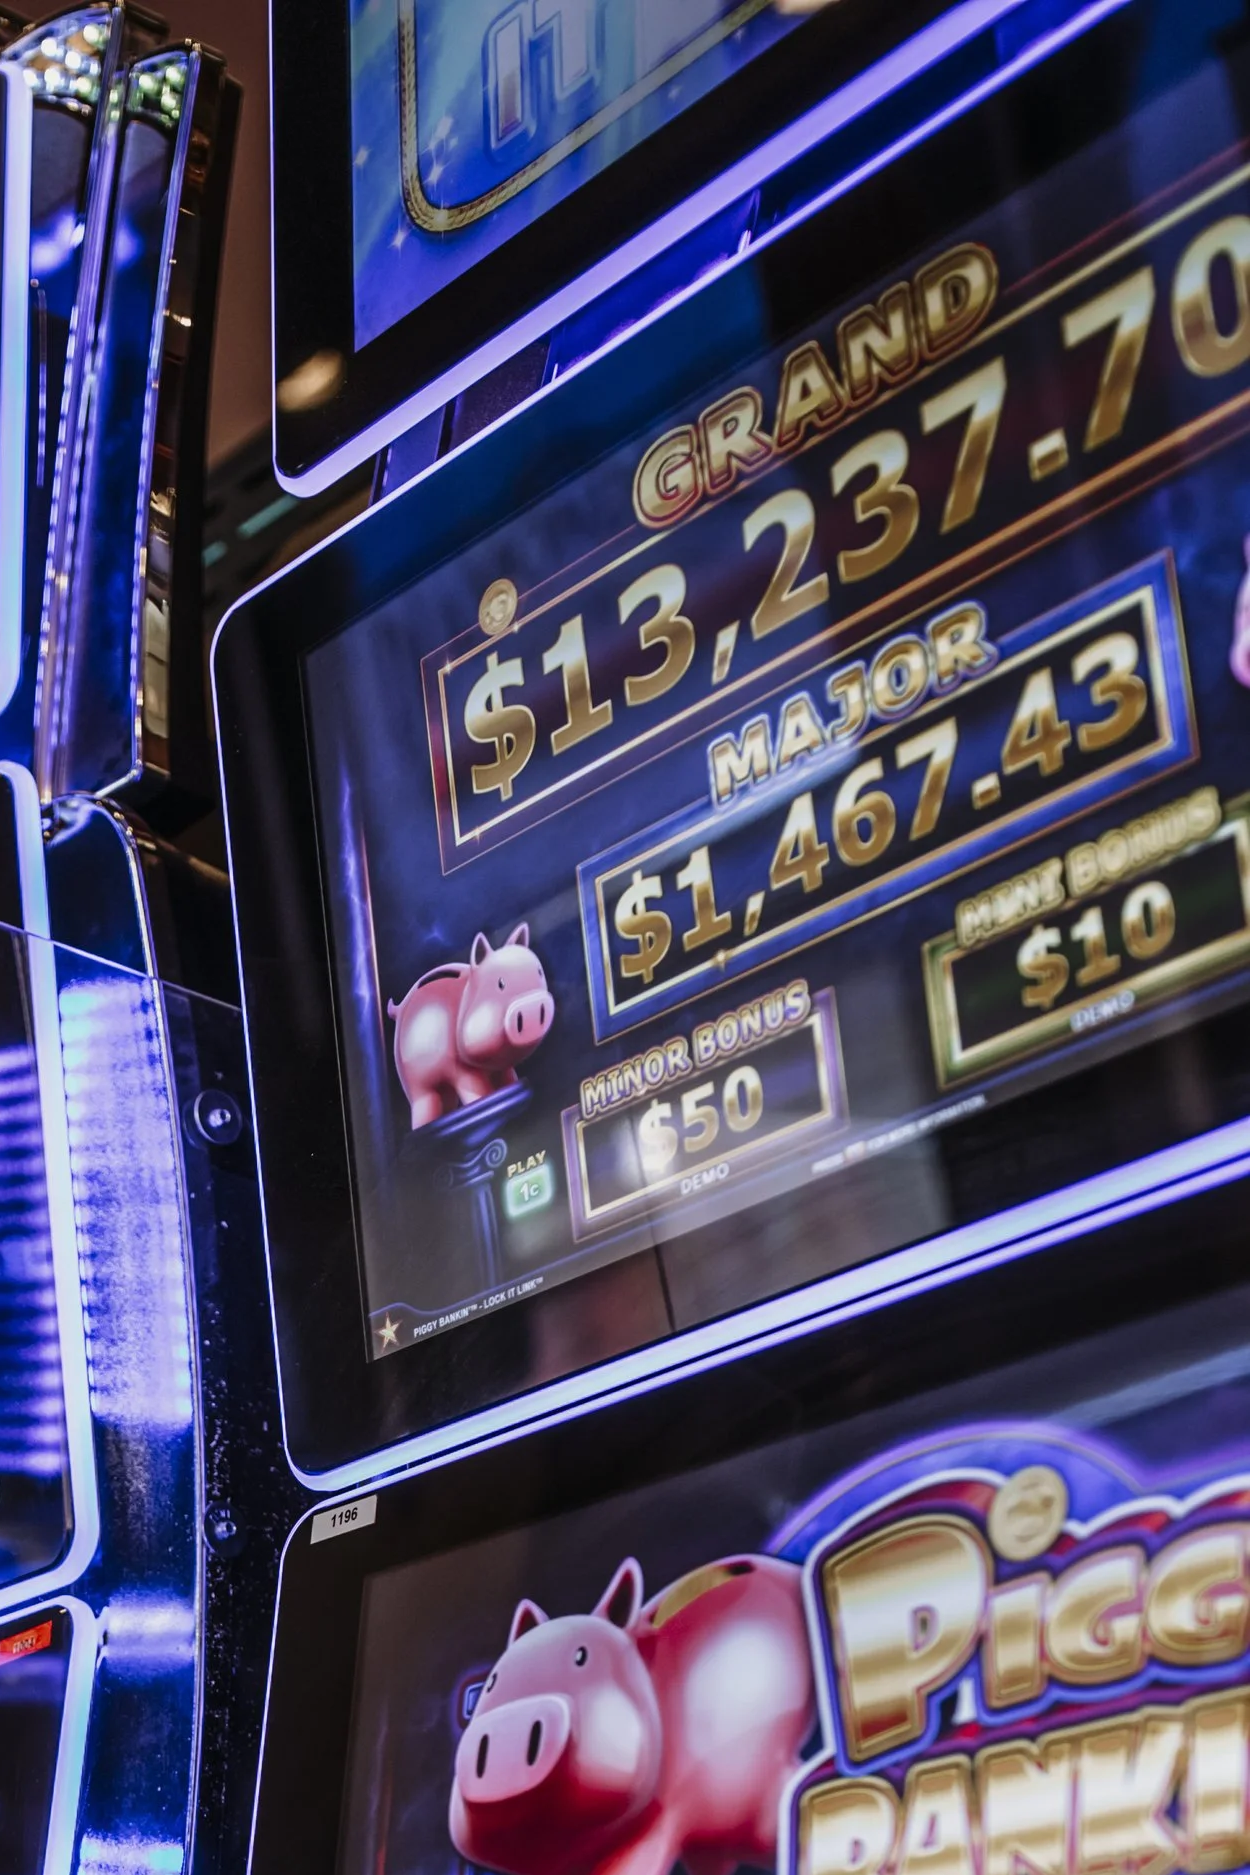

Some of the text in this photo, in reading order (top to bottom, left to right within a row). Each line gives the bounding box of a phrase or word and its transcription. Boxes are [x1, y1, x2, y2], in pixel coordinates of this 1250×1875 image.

[633, 242, 998, 529] GRAND
[462, 215, 1250, 802] $13,237.70
[707, 602, 1000, 806] MAJOR
[614, 632, 1150, 984] $1,467.43
[1064, 786, 1222, 898] BONUS
[1017, 880, 1176, 1011] $10
[579, 979, 811, 1119] MINOR BONUS
[1069, 988, 1135, 1033] DEMO
[507, 1149, 546, 1178] PLAY
[639, 1065, 764, 1175] $50
[680, 1163, 730, 1195] DEMO
[413, 1319, 437, 1338] PIGGY
[483, 1291, 506, 1309] LOCK
[507, 1287, 515, 1299] IT
[331, 1507, 358, 1528] 1196
[822, 1465, 1250, 1762] PIGG
